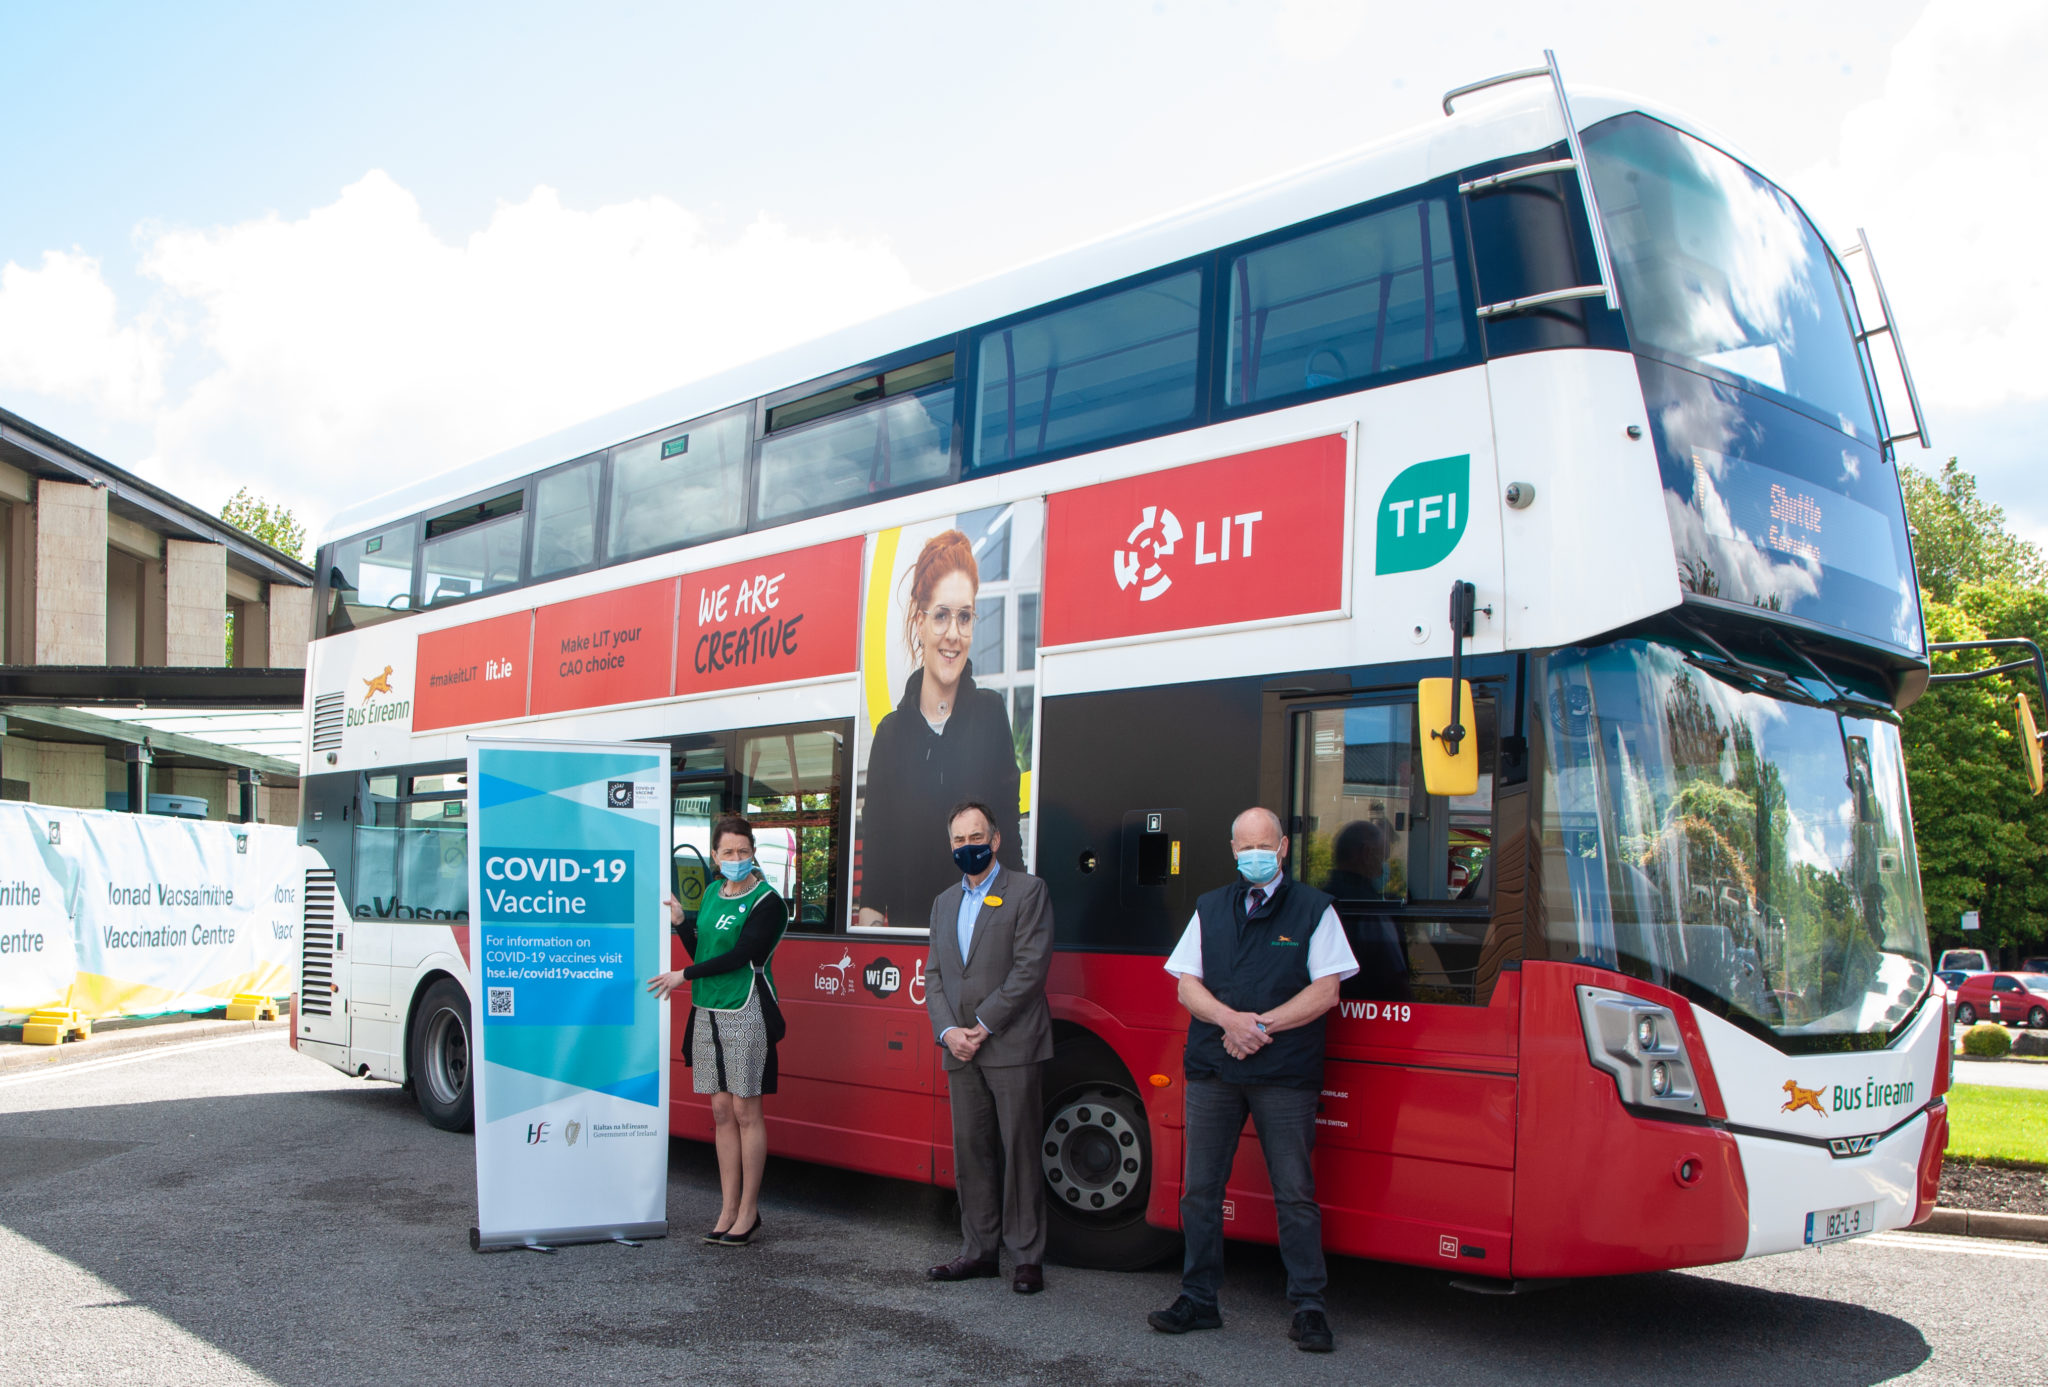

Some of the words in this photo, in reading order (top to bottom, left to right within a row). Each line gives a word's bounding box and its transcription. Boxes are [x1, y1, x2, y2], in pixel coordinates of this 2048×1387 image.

[1388, 492, 1457, 537] TFI
[1194, 510, 1263, 565] LIT
[699, 584, 731, 627] WE
[734, 572, 786, 617] ARE
[561, 634, 590, 655] Make
[593, 629, 611, 648] LIT
[612, 627, 642, 649] your
[694, 613, 804, 674] CREATIVE
[429, 666, 478, 688] #makeitLIT
[485, 657, 513, 681] lit.ie
[560, 659, 583, 678] CAO
[585, 652, 625, 673] choice
[346, 707, 366, 728] Bus
[485, 856, 628, 883] COVID-19
[108, 881, 151, 906] Ionad
[485, 888, 587, 914] Vaccine
[103, 924, 187, 949] Vaccination
[191, 923, 236, 946] Centre
[486, 935, 504, 946] For
[507, 936, 573, 948] information
[576, 940, 591, 948] on
[486, 951, 546, 963] COVID-19
[549, 953, 597, 964] vaccines
[599, 953, 623, 964] visit
[486, 967, 614, 980] hse.ie/covid19vaccine
[814, 972, 840, 995] leap
[1340, 1001, 1378, 1020] VWD
[1381, 1004, 1411, 1022] 419
[1833, 1085, 1862, 1112] Bus
[636, 1129, 658, 1137] Ireland
[1826, 1209, 1860, 1238] 182-L-9
